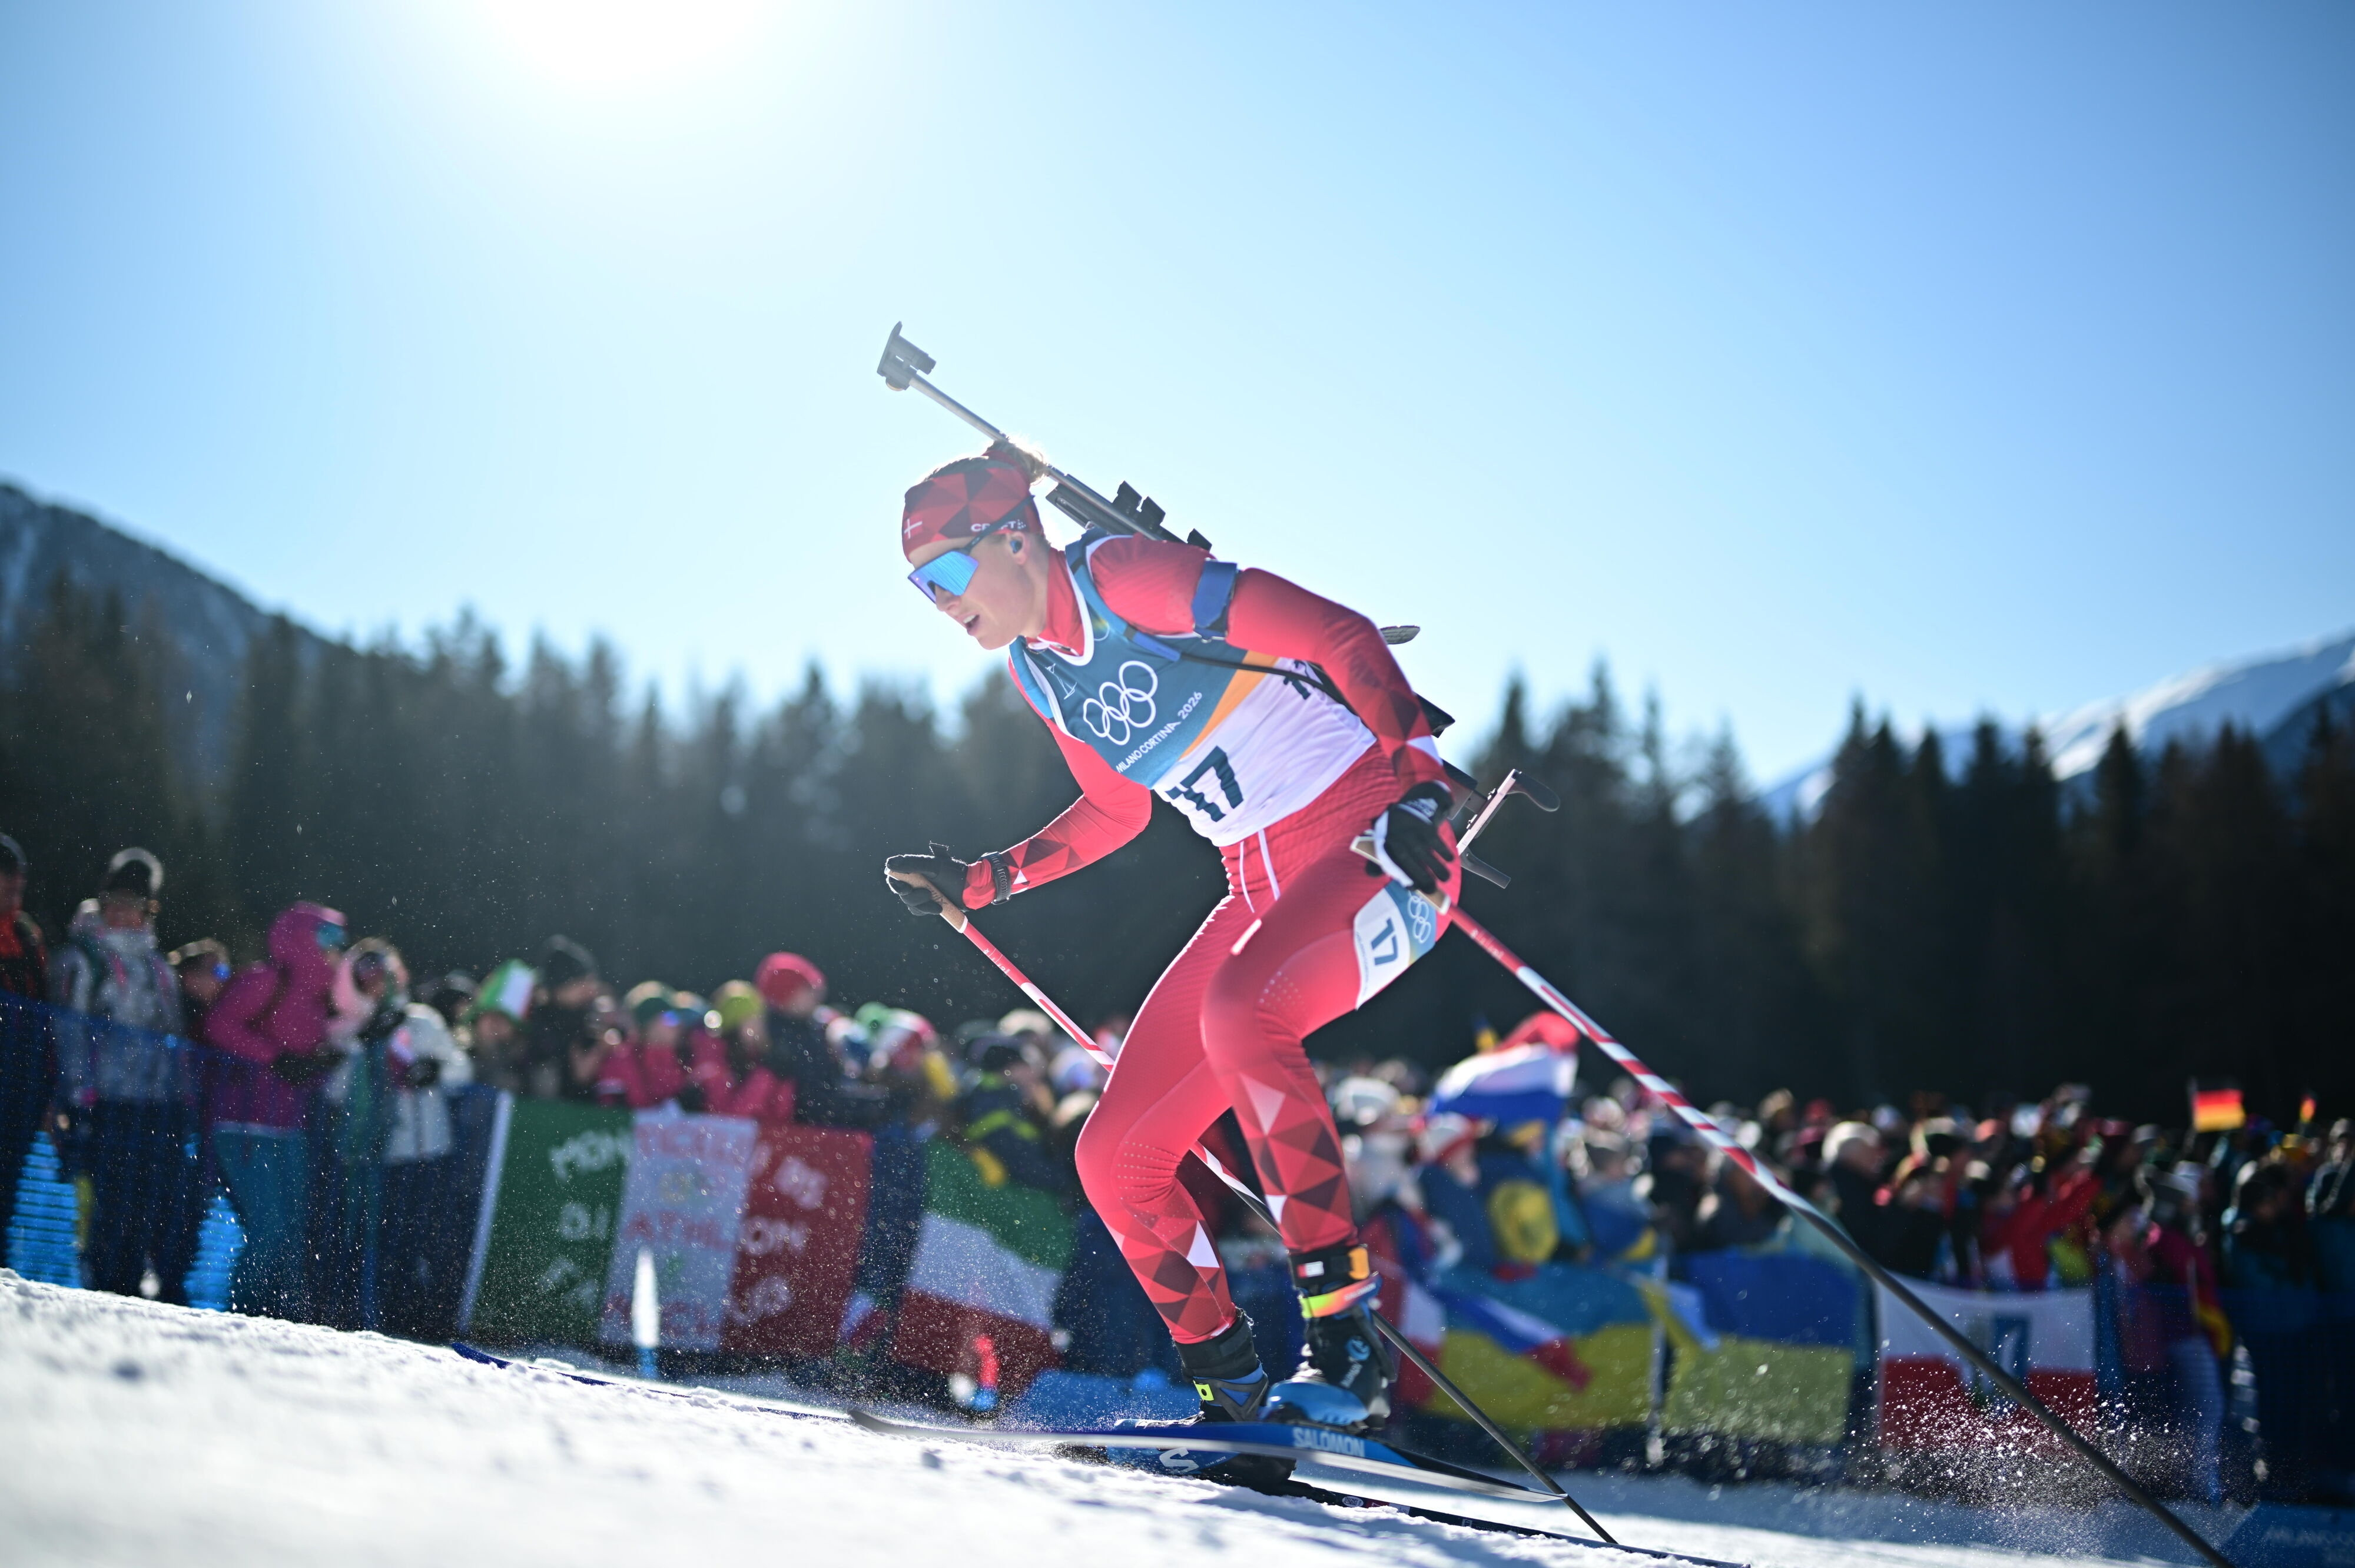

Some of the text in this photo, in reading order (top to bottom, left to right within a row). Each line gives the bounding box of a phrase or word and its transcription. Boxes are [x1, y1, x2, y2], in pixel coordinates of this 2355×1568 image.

[1116, 691, 1202, 773] MILANO CORTINA 2026
[1165, 745, 1243, 822] 17
[1371, 917, 1398, 965] 17
[1293, 1426, 1366, 1457] SALOMON
